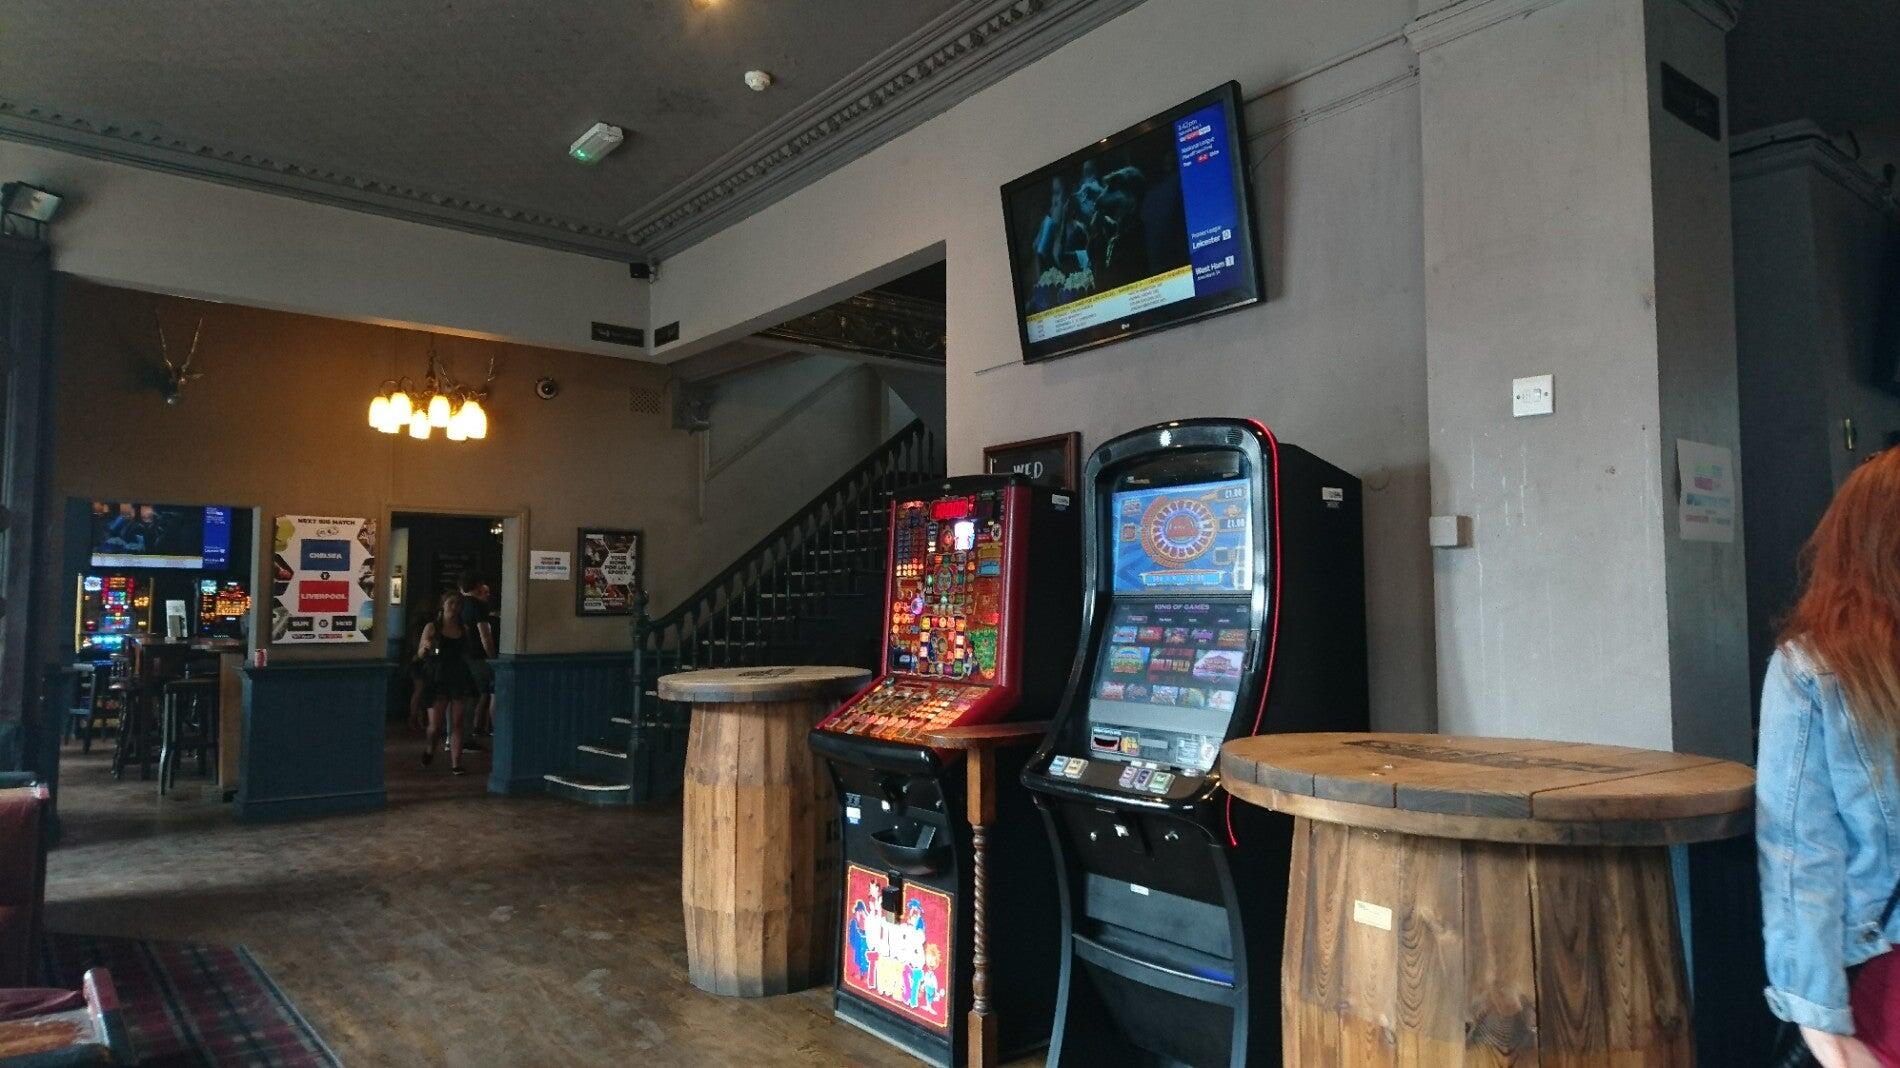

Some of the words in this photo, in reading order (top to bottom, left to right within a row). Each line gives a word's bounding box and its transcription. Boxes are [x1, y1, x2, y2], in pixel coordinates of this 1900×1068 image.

[1192, 235, 1221, 250] Leicester
[1196, 265, 1210, 275] West
[1211, 261, 1225, 271] Ham
[1013, 461, 1043, 479] WED
[309, 552, 342, 560] CHELSEA
